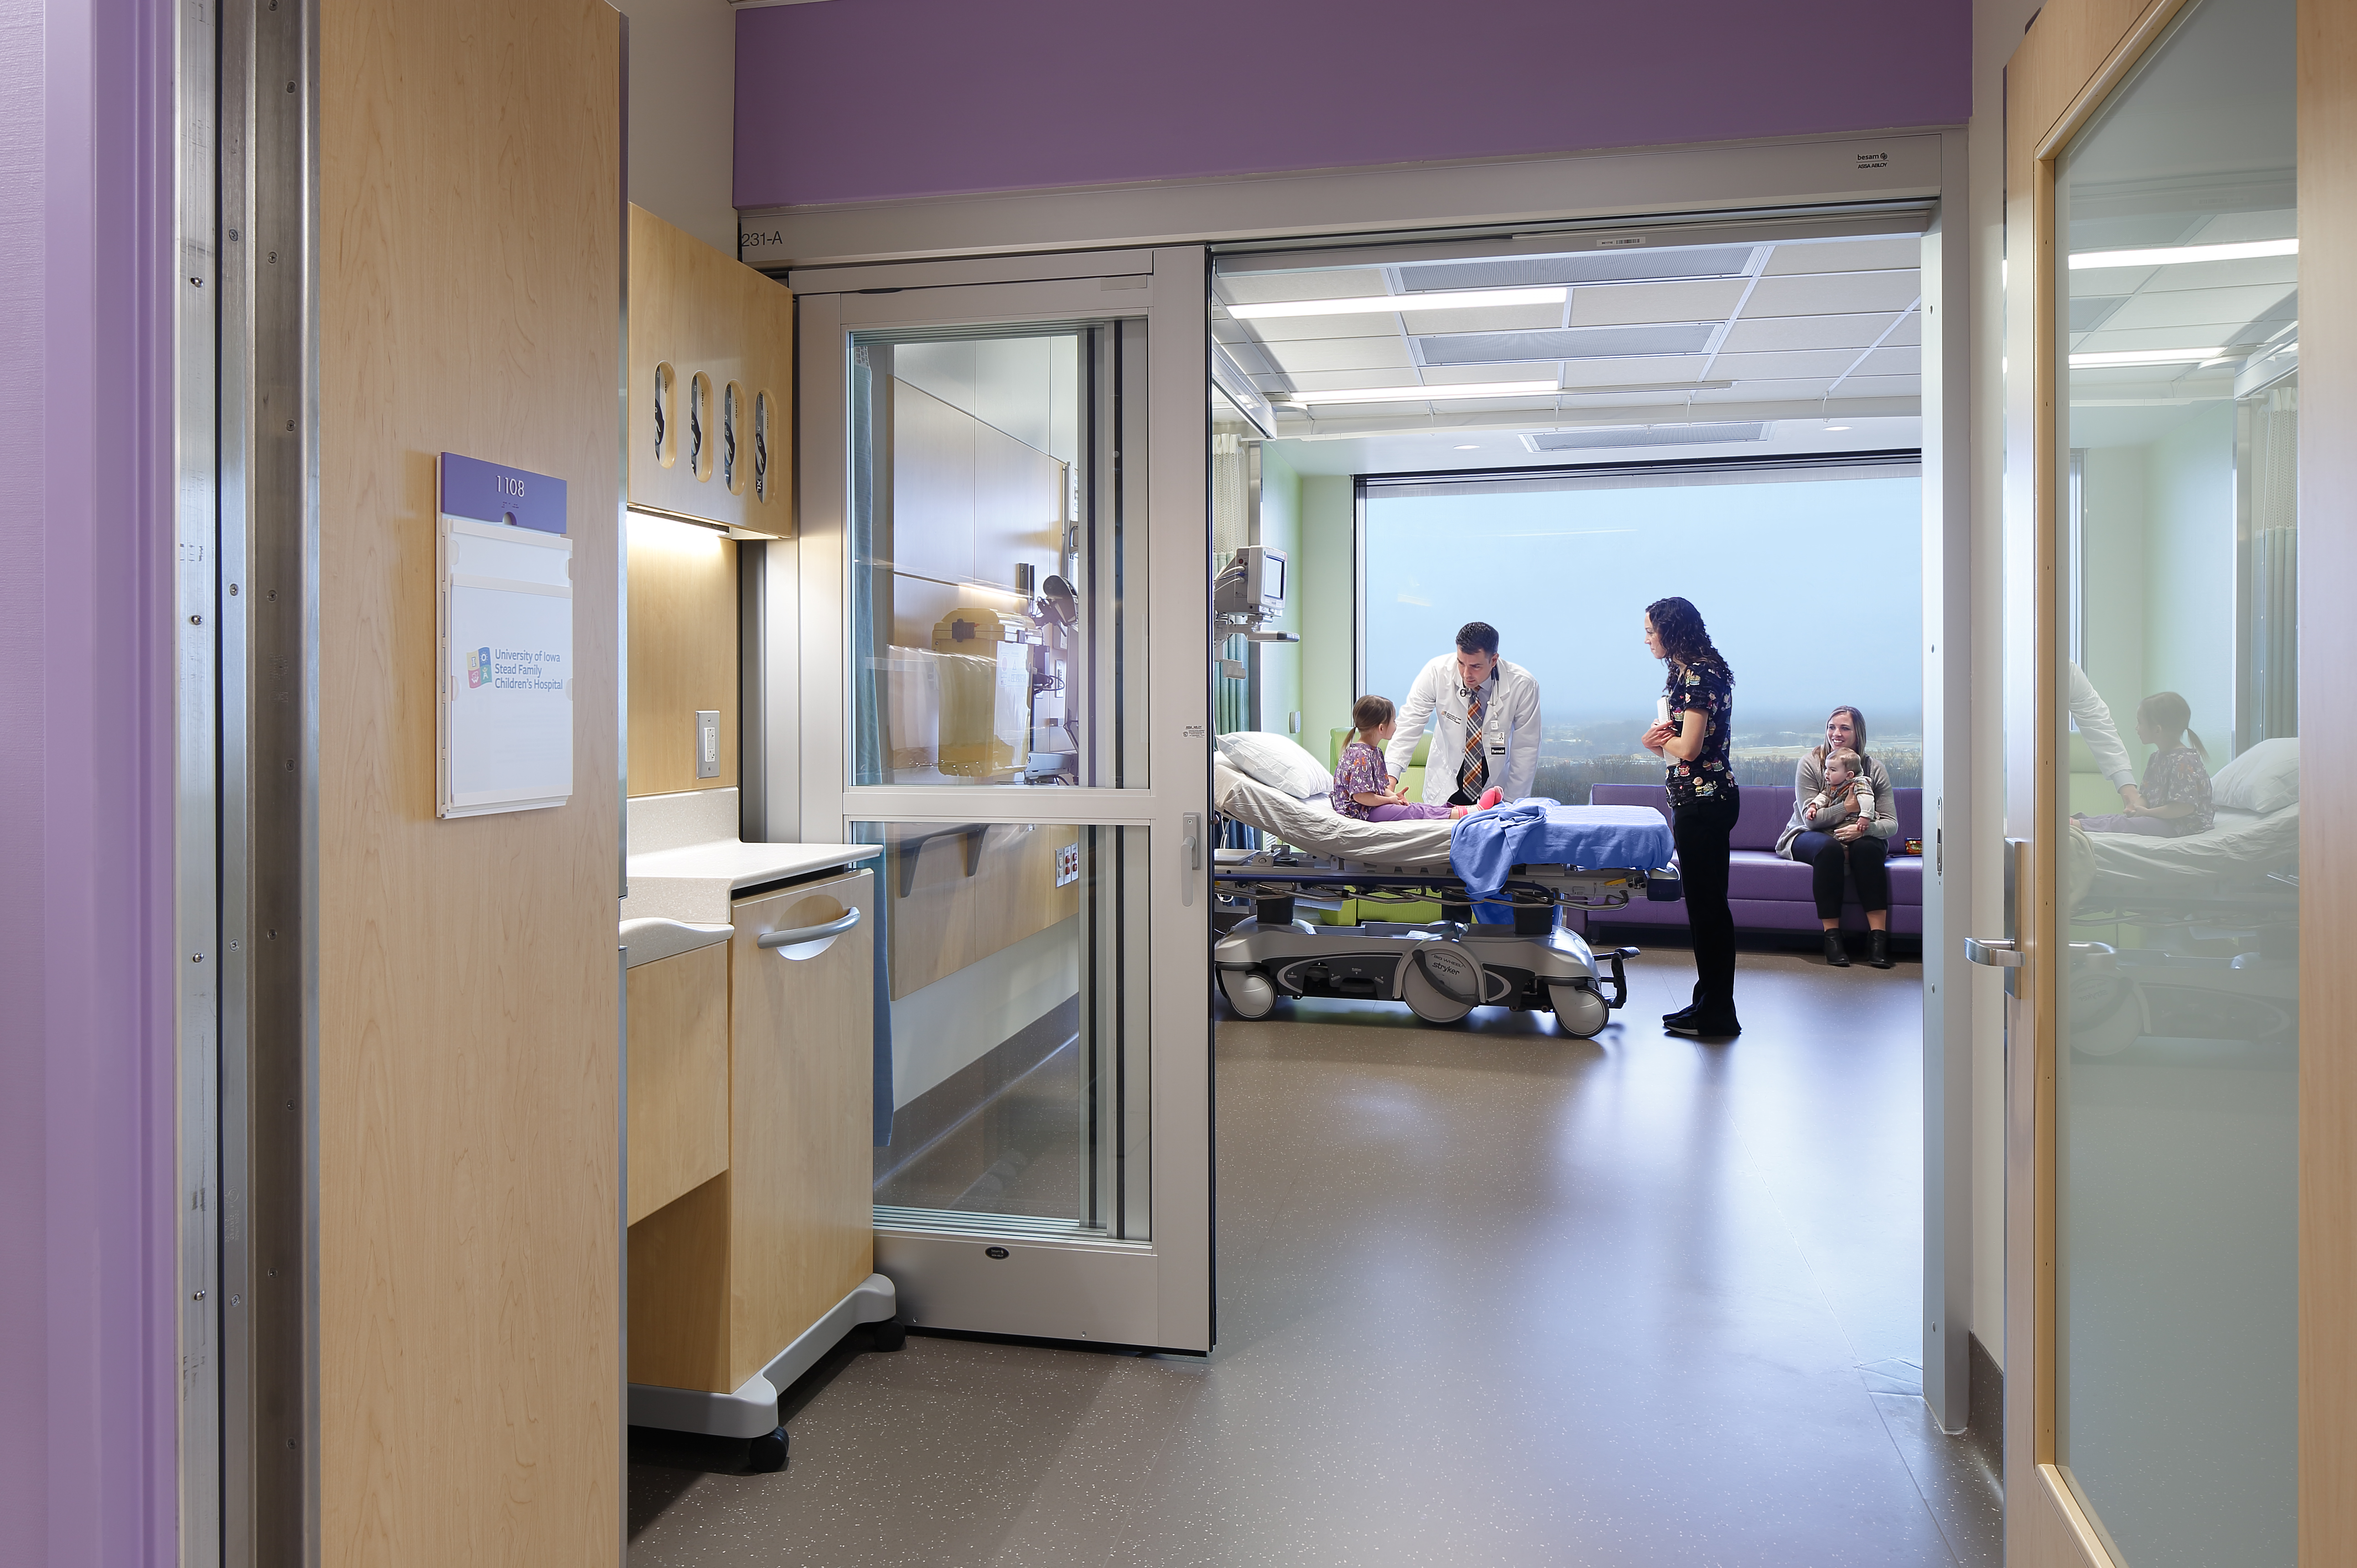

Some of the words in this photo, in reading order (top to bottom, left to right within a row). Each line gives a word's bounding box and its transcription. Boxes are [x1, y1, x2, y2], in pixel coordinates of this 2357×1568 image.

[742, 231, 783, 247] 231-A
[496, 475, 524, 497] 1108
[757, 480, 761, 492] XL
[495, 649, 533, 664] University
[535, 651, 542, 661] of
[544, 652, 560, 662] Iowa
[495, 664, 516, 674] Stead
[519, 665, 542, 678] Family
[534, 679, 563, 692] Hospital
[1432, 962, 1459, 975] stryker
[1443, 958, 1462, 967] WHEEL
